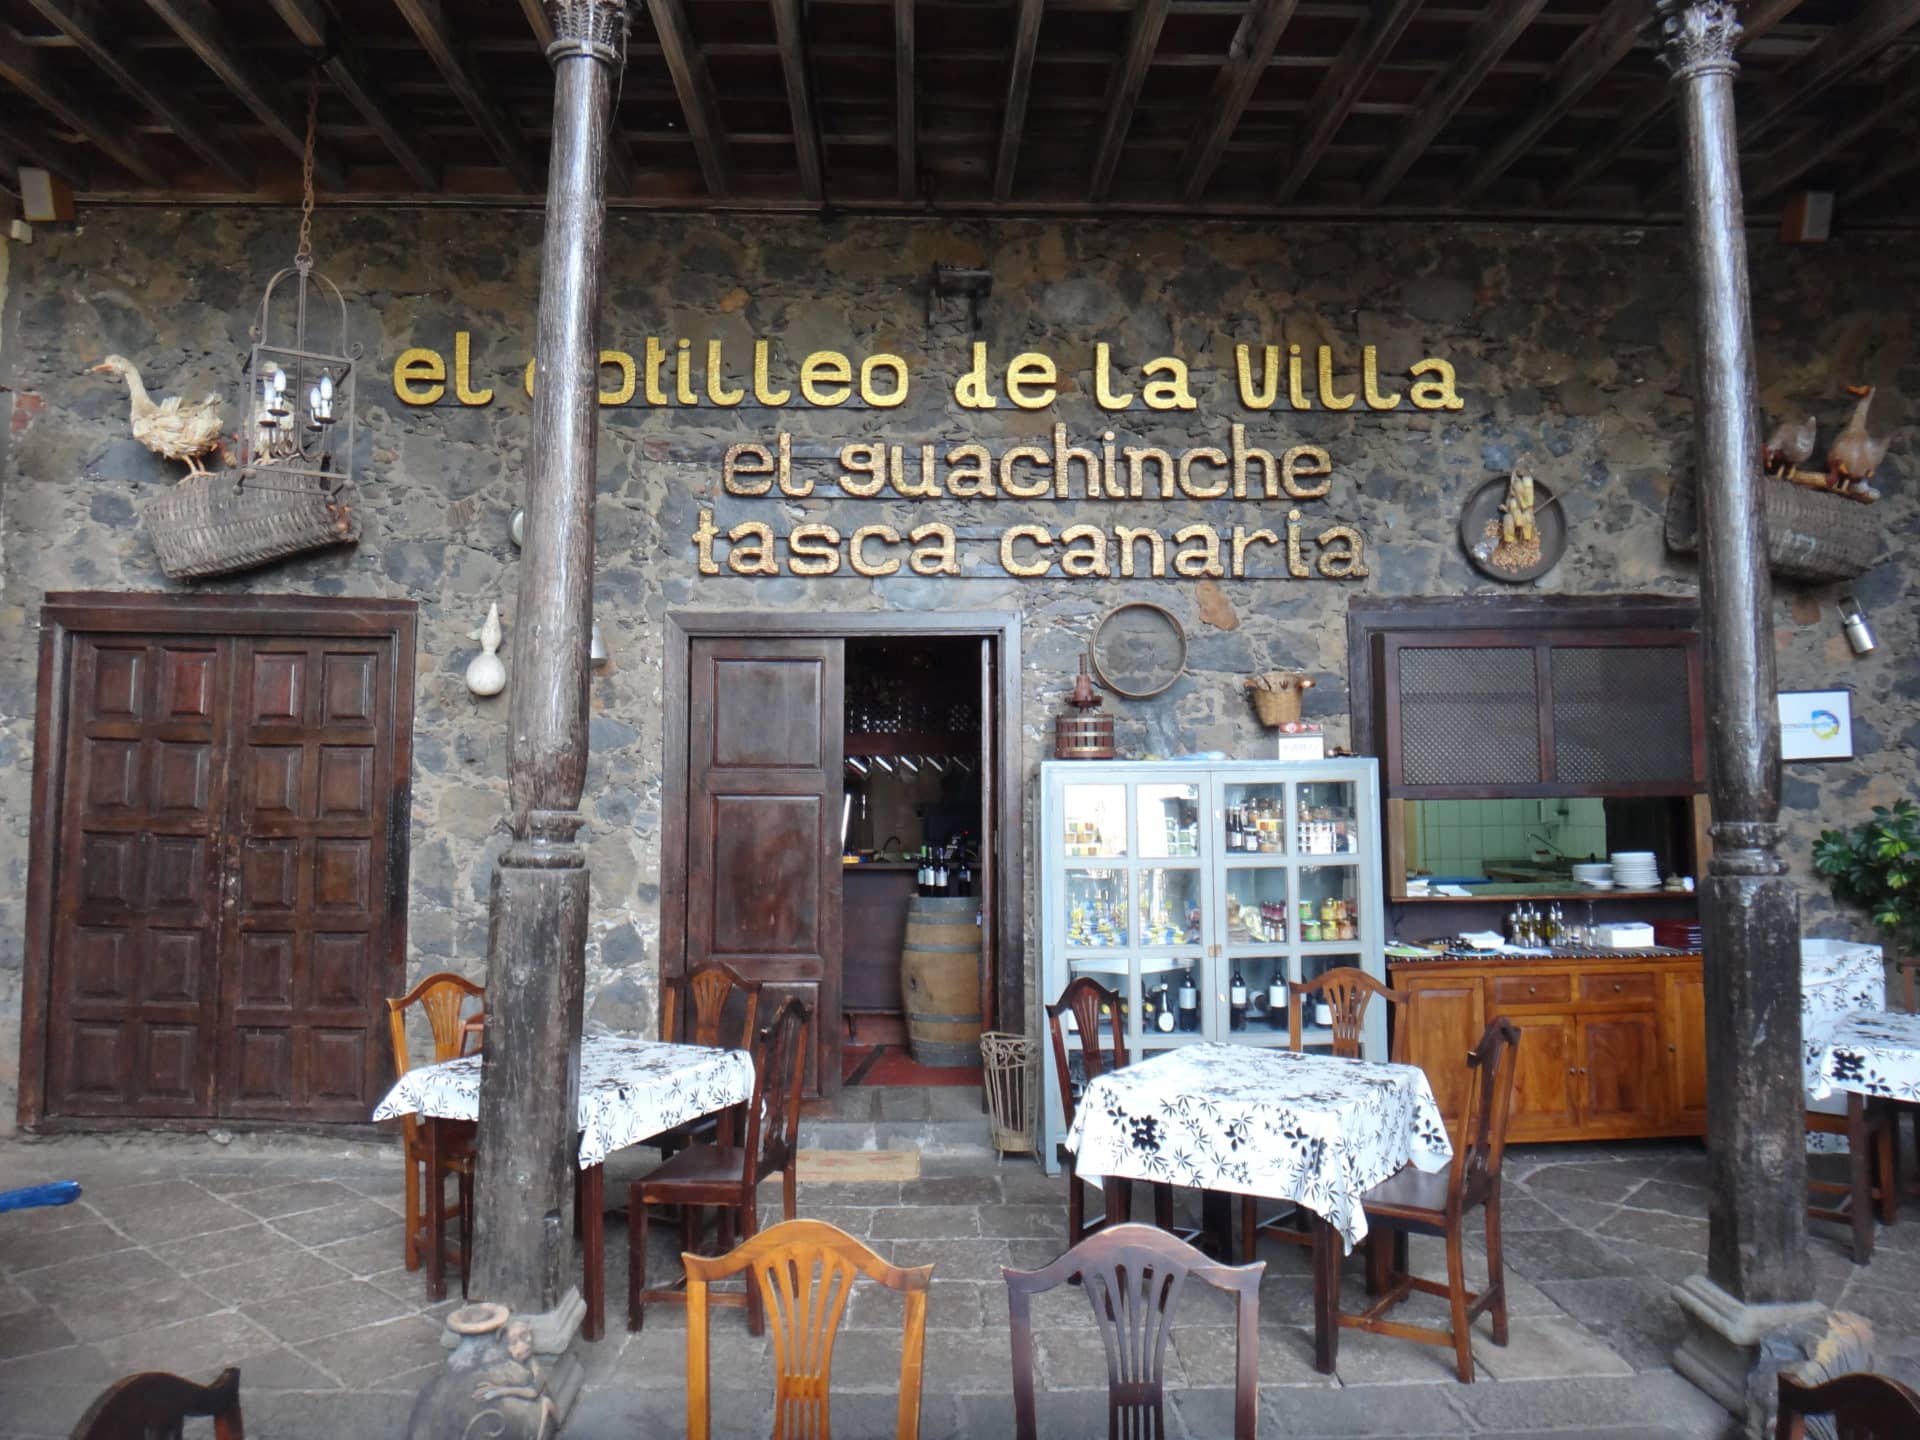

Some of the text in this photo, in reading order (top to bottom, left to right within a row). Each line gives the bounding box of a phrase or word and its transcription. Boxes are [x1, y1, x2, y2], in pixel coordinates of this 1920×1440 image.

[394, 331, 1465, 410] el otilleo de la Villa
[723, 422, 1333, 499] el guachinche
[691, 508, 1370, 579] tasca canaria
